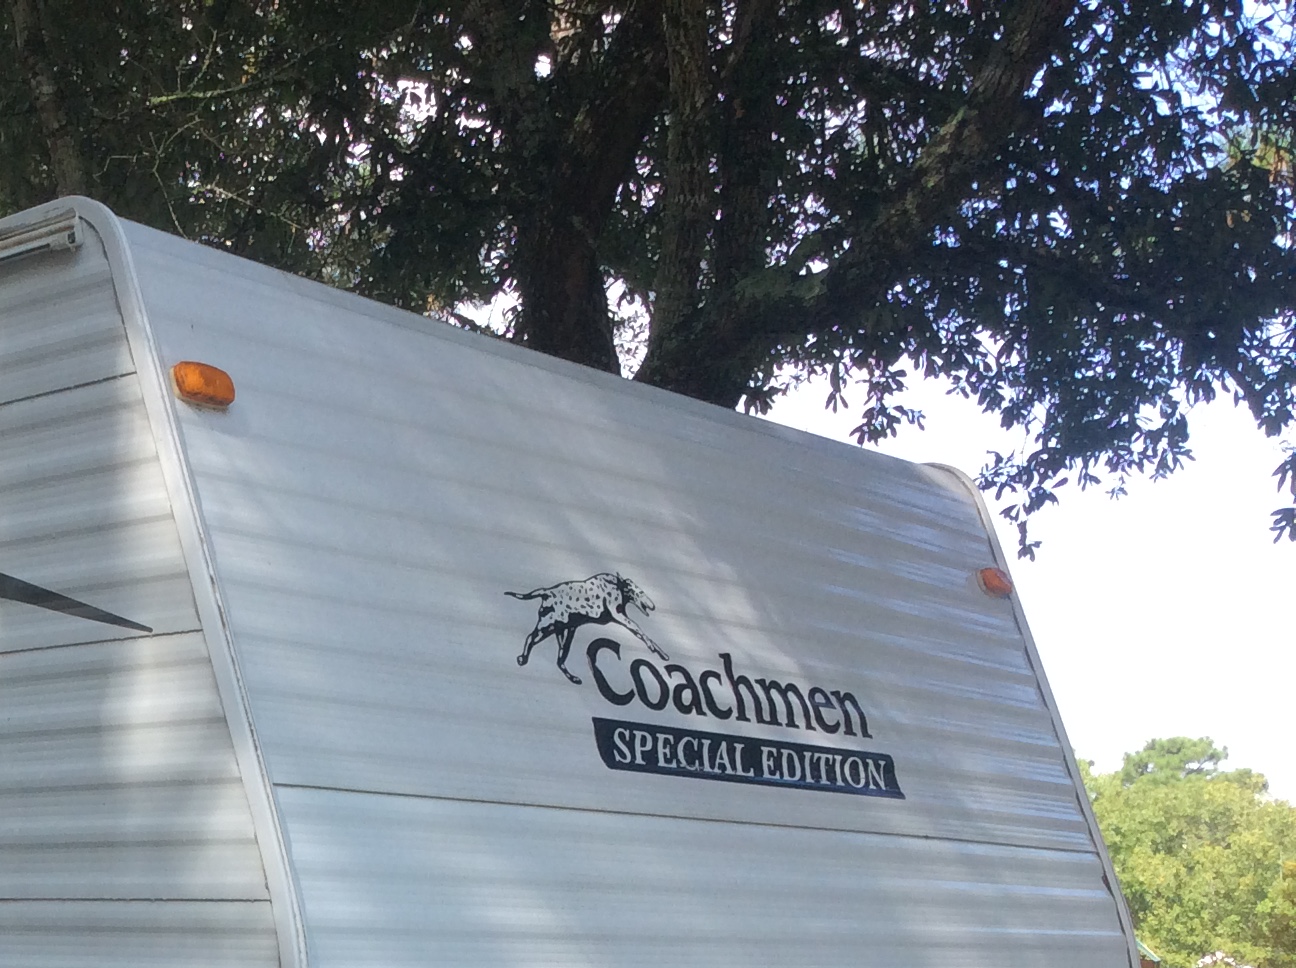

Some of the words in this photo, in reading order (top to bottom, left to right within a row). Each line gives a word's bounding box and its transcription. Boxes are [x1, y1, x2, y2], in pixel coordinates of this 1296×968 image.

[586, 637, 873, 739] Coachmen
[612, 727, 754, 777] SPECIAL
[760, 746, 887, 792] EDITION
